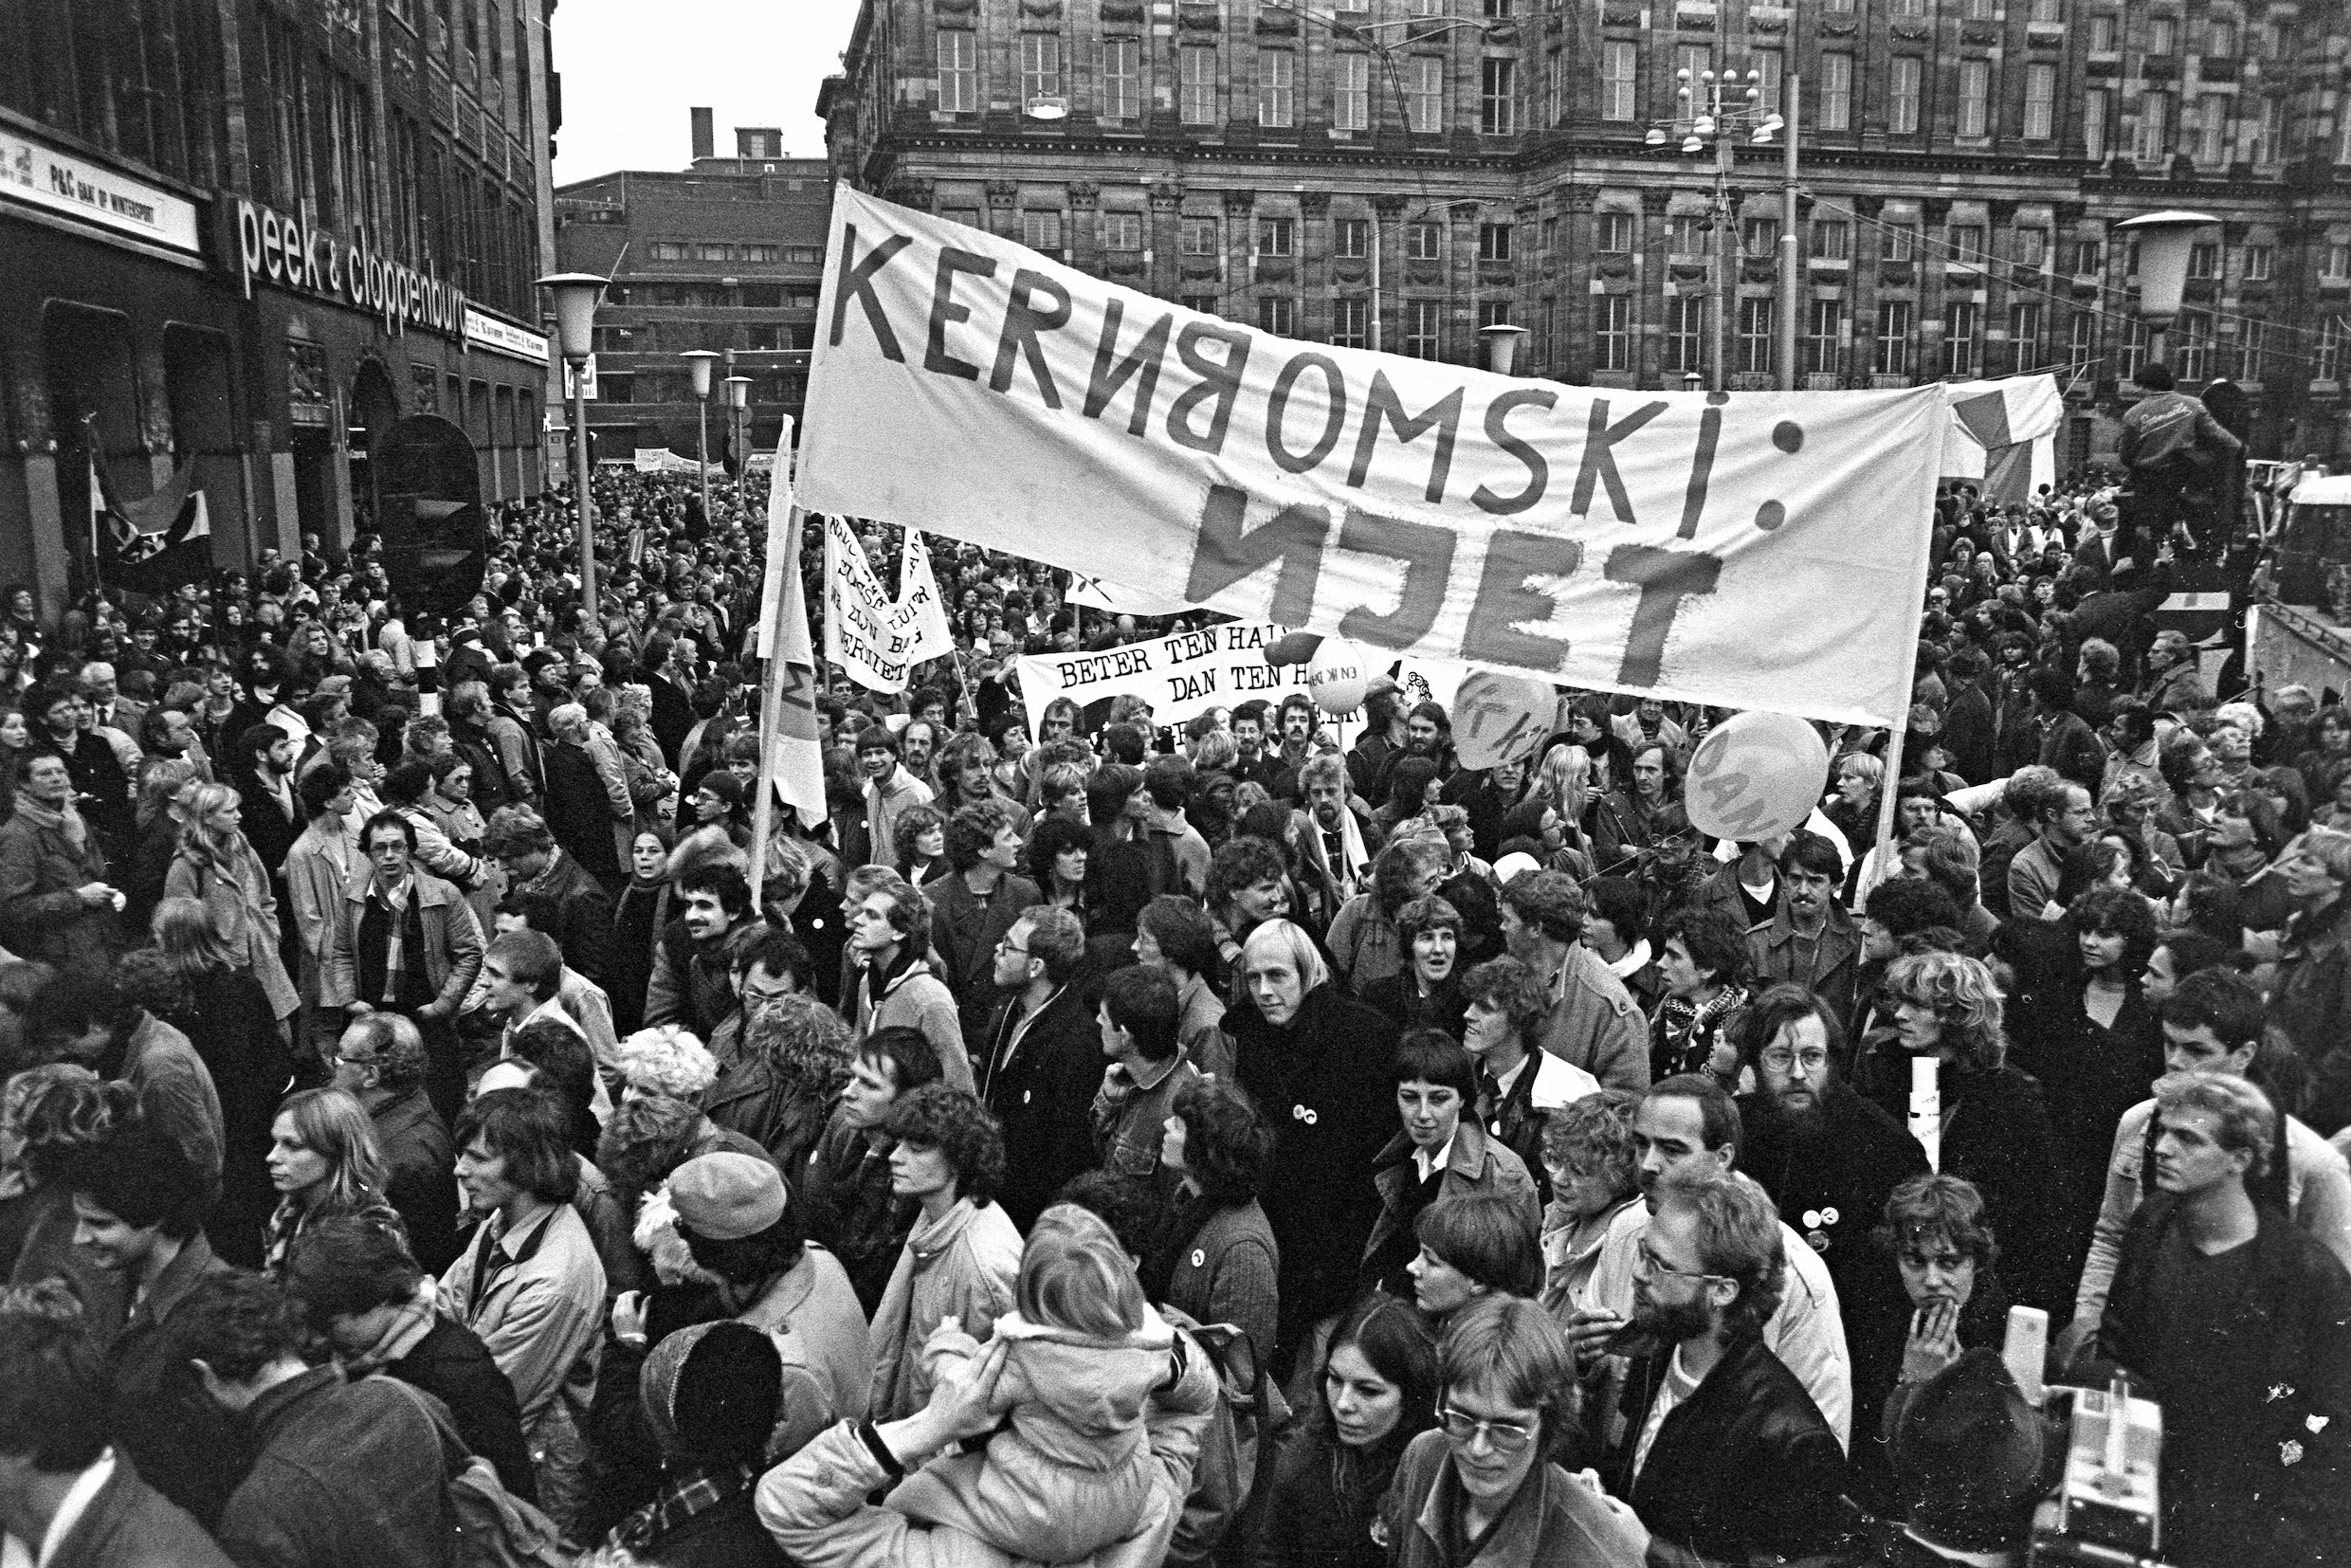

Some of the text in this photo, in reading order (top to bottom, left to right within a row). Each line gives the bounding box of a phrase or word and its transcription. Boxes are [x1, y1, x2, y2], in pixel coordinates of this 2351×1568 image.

[239, 198, 322, 300] peek
[349, 226, 469, 356] cloppenburg
[1057, 648, 1153, 689] BETER
[1164, 629, 1218, 665] TEN
[1168, 667, 1216, 702] DAN
[1230, 664, 1281, 691] TEN
